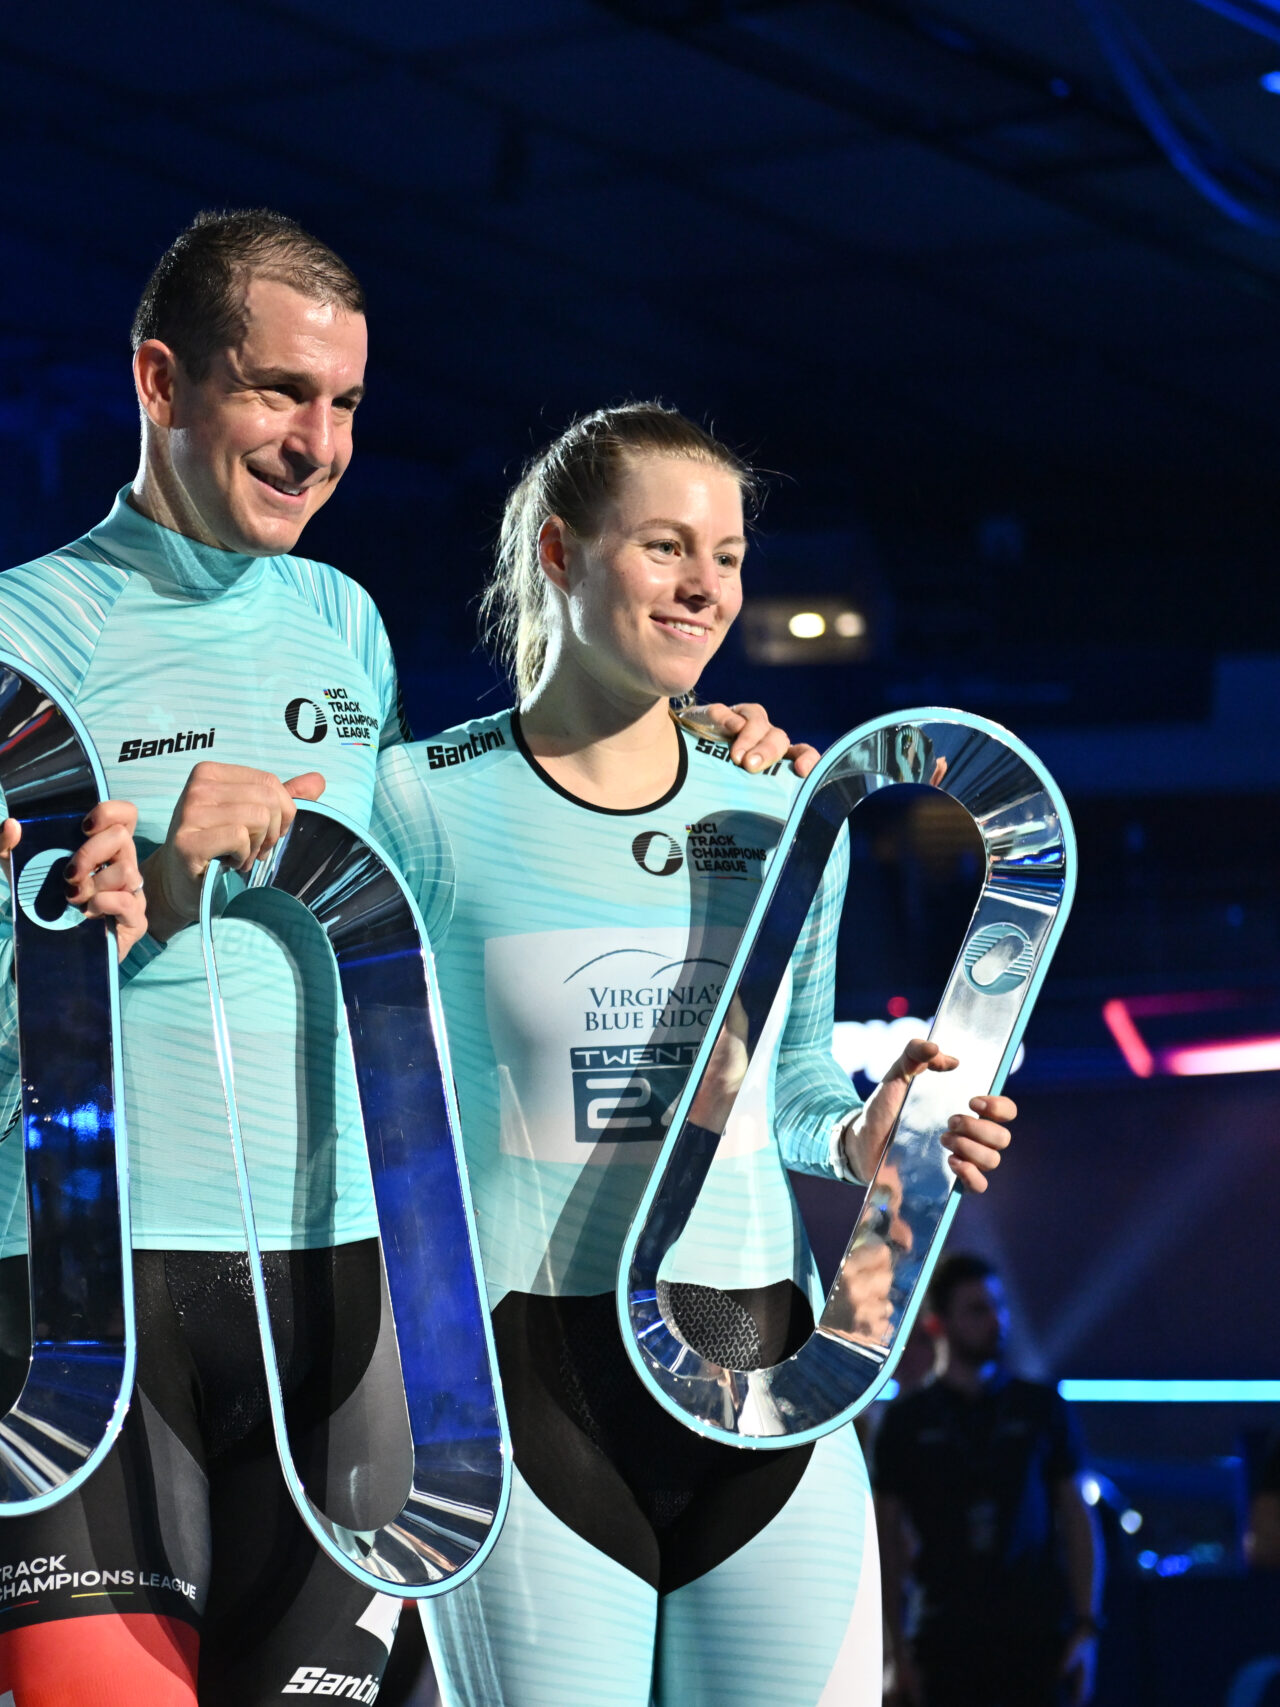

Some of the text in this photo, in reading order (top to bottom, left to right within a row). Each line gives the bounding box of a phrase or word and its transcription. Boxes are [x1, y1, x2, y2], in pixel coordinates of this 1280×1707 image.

[327, 688, 348, 699] UCI
[328, 701, 361, 713] TRACK
[333, 714, 379, 730] CHAMPIONS
[336, 727, 371, 739] LEAGUE
[118, 728, 216, 763] Santini
[426, 728, 506, 770] Santini
[691, 823, 718, 834] UCI
[688, 835, 736, 846] TRACK
[692, 848, 767, 861] CHAMPIONS
[695, 860, 748, 873] LEAGUE
[584, 1010, 644, 1032] BLUE
[139, 1571, 197, 1600] LEAGUE
